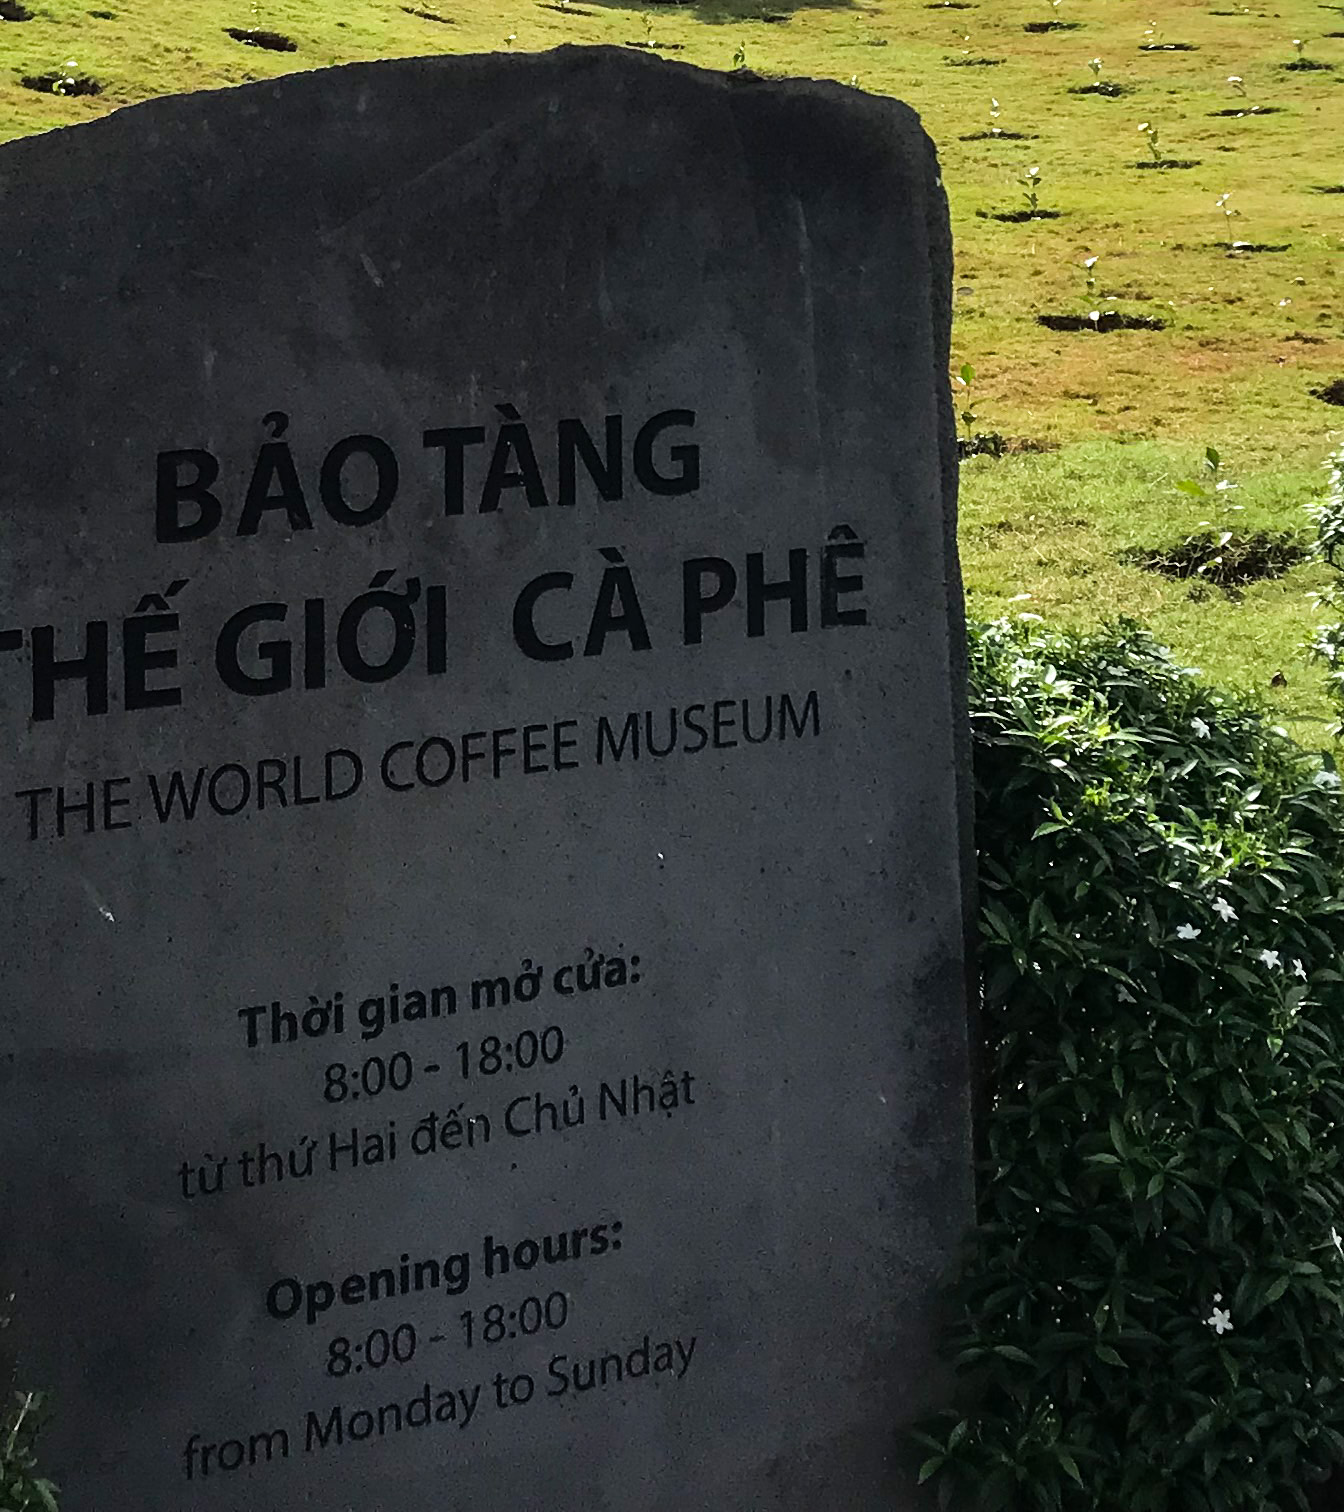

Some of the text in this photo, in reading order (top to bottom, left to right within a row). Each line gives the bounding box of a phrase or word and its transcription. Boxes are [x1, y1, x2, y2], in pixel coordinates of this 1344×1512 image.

[154, 402, 701, 545] BẢO TÀNG
[215, 568, 449, 698] GIỚI
[512, 547, 653, 663] CÀ
[681, 523, 869, 647] PHÊ
[15, 691, 823, 843] THE WORLD COFFEE MUSEUM
[238, 946, 642, 1049] Thời gian mở cửa:
[322, 1024, 566, 1105] 8:00 - 18:00
[178, 1069, 697, 1200] từ thứ Hai đến Chủ Nhật
[265, 1219, 625, 1325] Opening hours:
[325, 1321, 418, 1378] 8:00
[460, 1290, 569, 1349] 18:00
[182, 1334, 698, 1481] from Monday to Sunday
